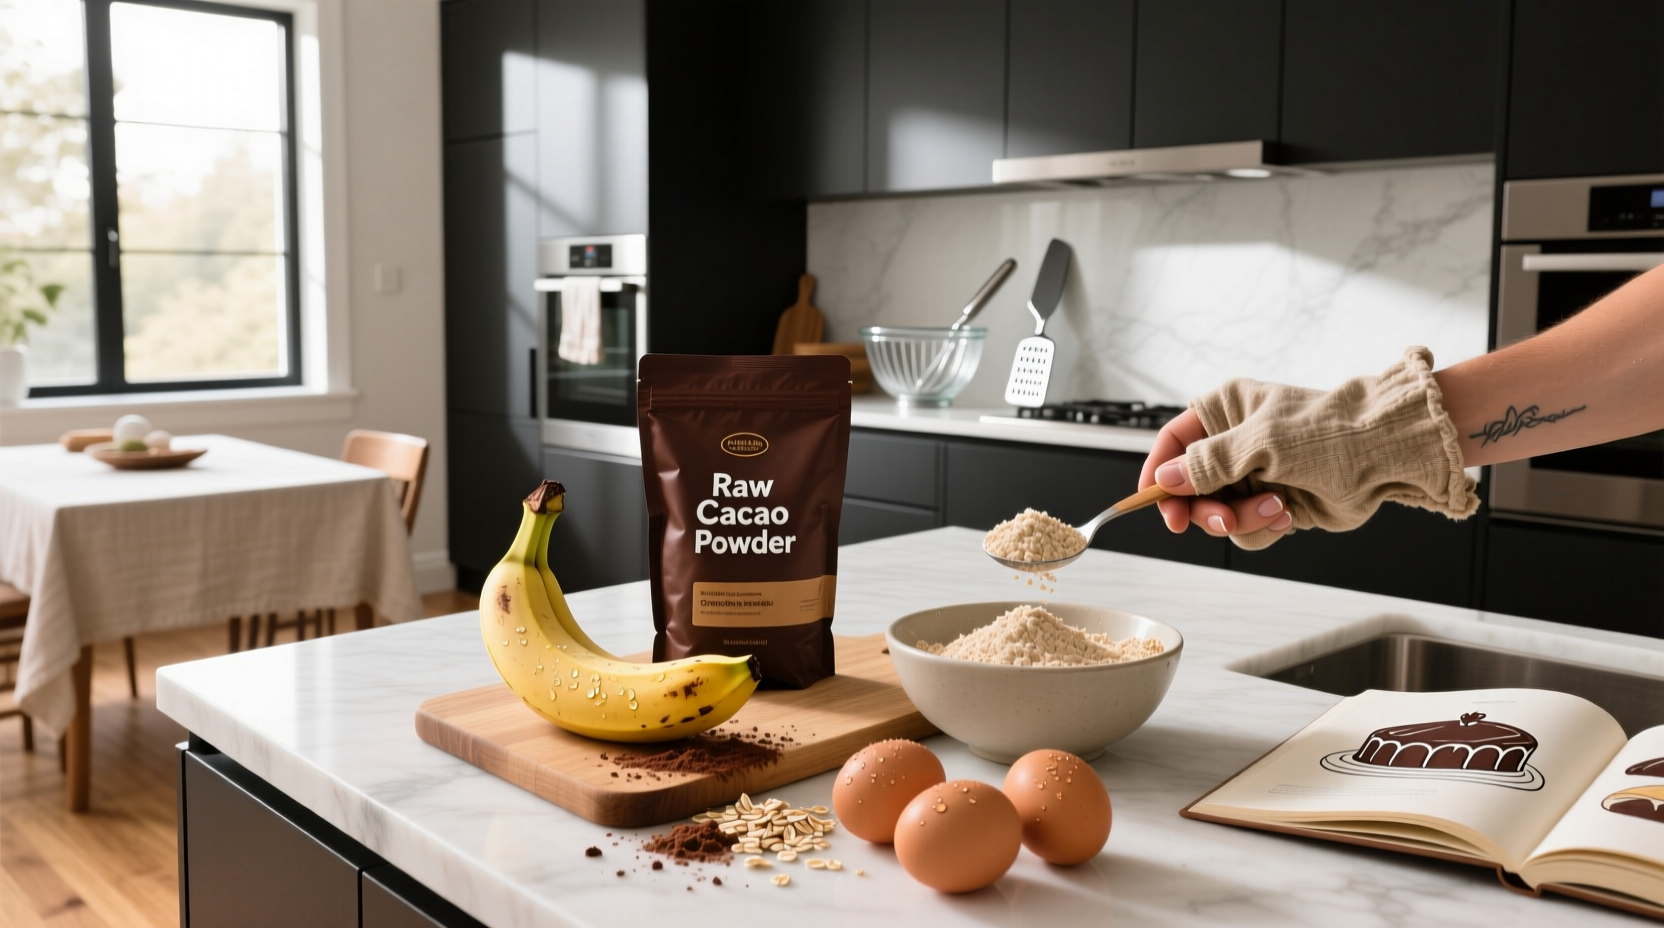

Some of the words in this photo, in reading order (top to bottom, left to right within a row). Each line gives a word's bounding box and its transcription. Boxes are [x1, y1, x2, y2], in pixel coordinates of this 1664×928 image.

[712, 472, 774, 498] Raw
[696, 499, 789, 525] Cacao
[695, 529, 796, 554] Powder
